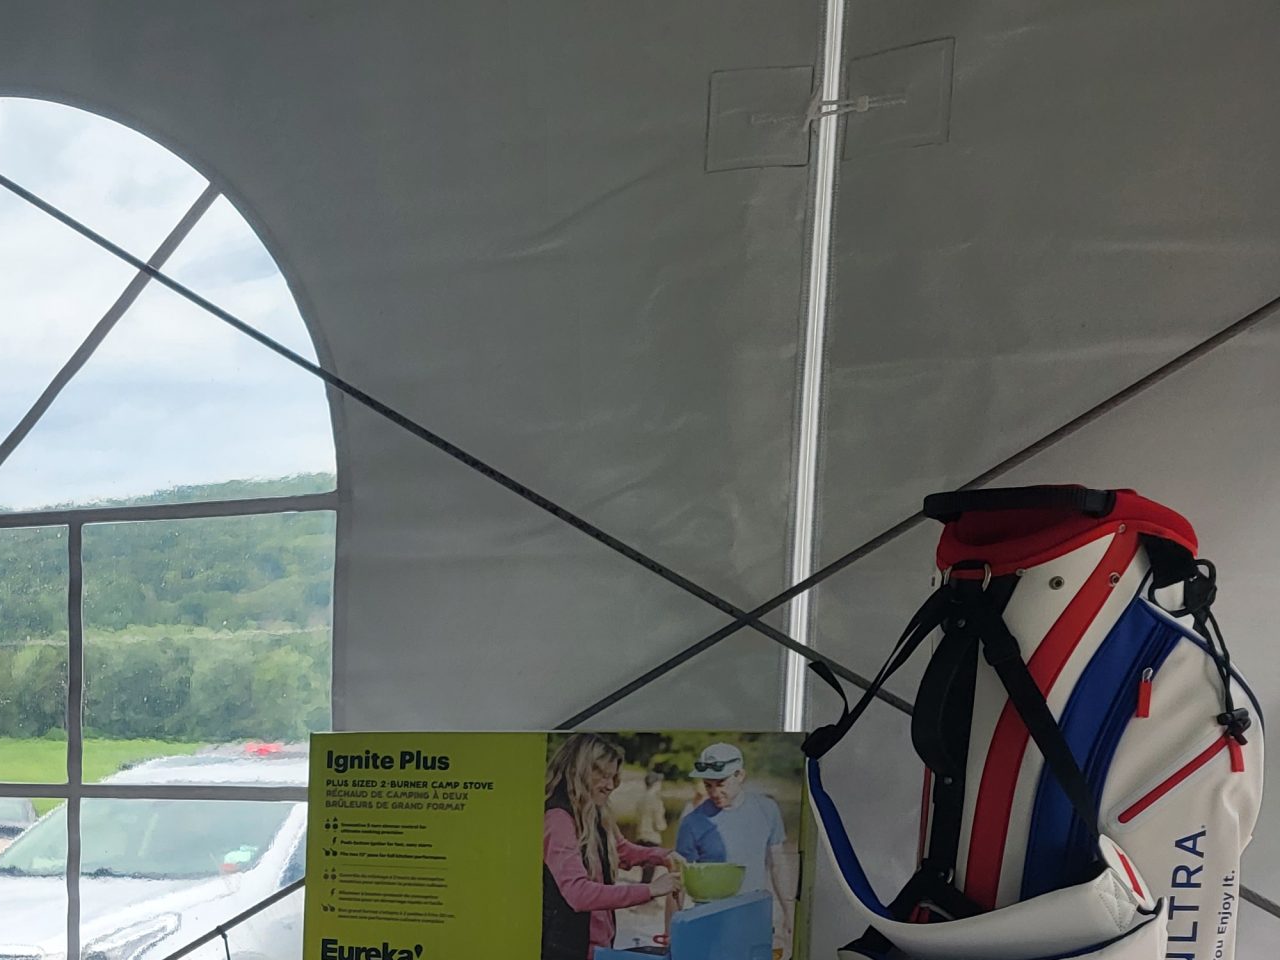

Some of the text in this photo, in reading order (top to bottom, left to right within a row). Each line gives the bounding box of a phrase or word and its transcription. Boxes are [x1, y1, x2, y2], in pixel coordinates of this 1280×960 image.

[326, 750, 450, 774] Ignite Plus
[326, 779, 494, 790] PLUS SIZED 2-BURNER CAMP STOVE
[326, 788, 369, 798] RÉCHAUD
[371, 790, 383, 799] DE
[387, 791, 430, 800] CAMPING
[442, 792, 469, 800] DEUX
[325, 798, 466, 811] BRÛLEURS DE GRAND FORMAT
[1222, 870, 1235, 886] It.
[1217, 892, 1235, 935] Enjoy
